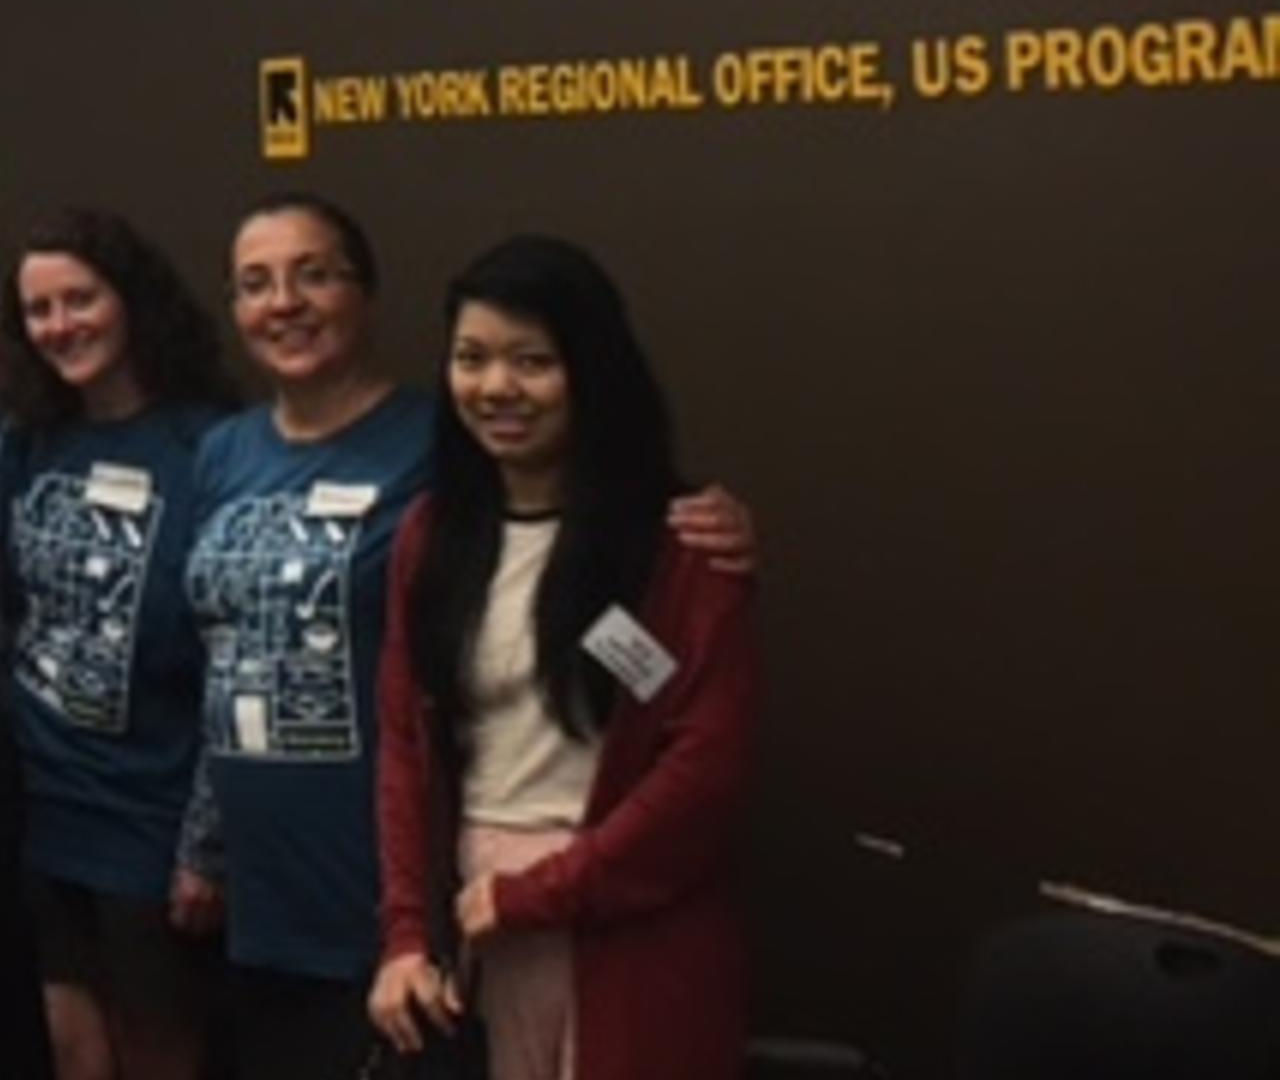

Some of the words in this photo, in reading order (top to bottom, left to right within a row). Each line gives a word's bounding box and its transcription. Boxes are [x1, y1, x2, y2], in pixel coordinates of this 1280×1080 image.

[314, 77, 386, 123] NEW
[395, 70, 491, 117] YORK
[498, 57, 703, 114] REGIONAL
[713, 43, 894, 109] OFFICE,
[912, 35, 990, 97] US
